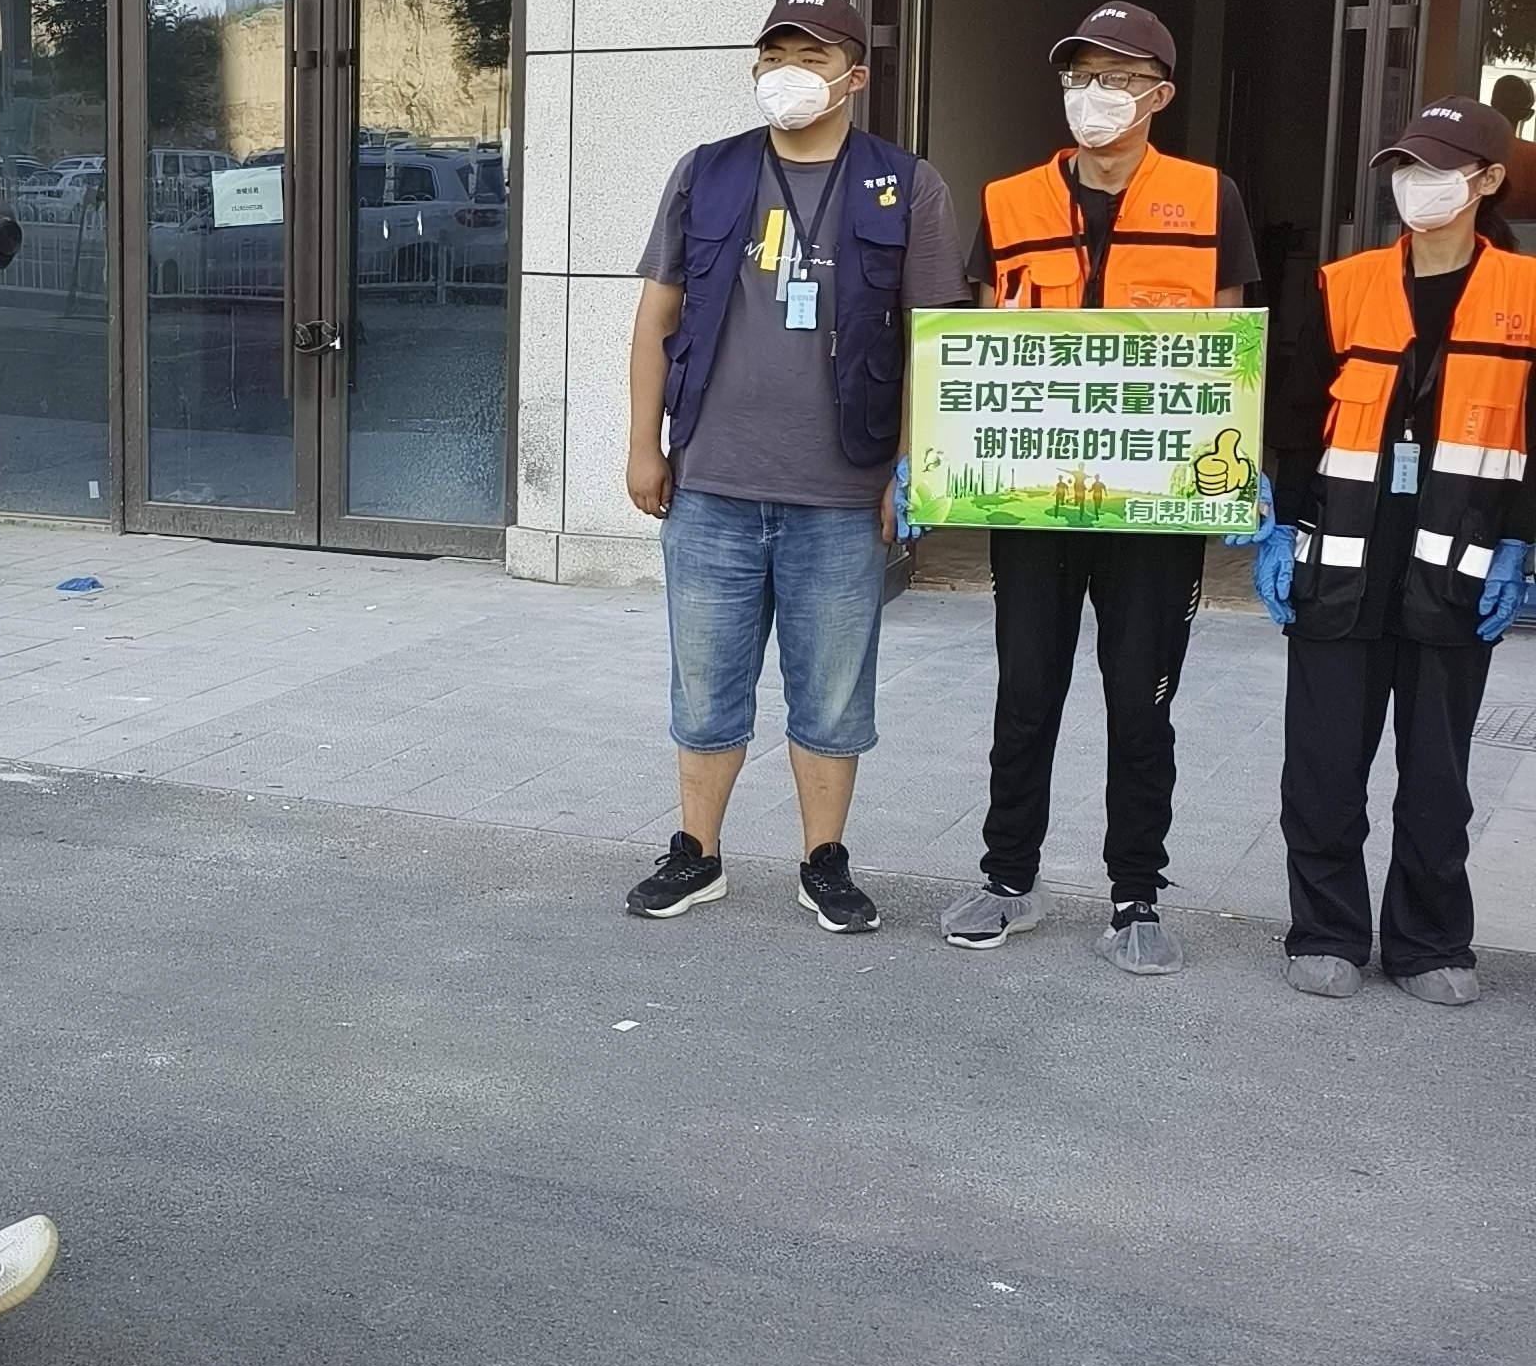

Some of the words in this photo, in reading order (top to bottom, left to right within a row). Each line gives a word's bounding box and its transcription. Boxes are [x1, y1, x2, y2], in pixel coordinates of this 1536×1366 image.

[939, 333, 1235, 368] 已为您家甲醛治理
[938, 379, 1233, 416] 室内空气质量达标
[973, 426, 1193, 462] 谢谢您的信任
[1126, 499, 1251, 525] 有帮科技
